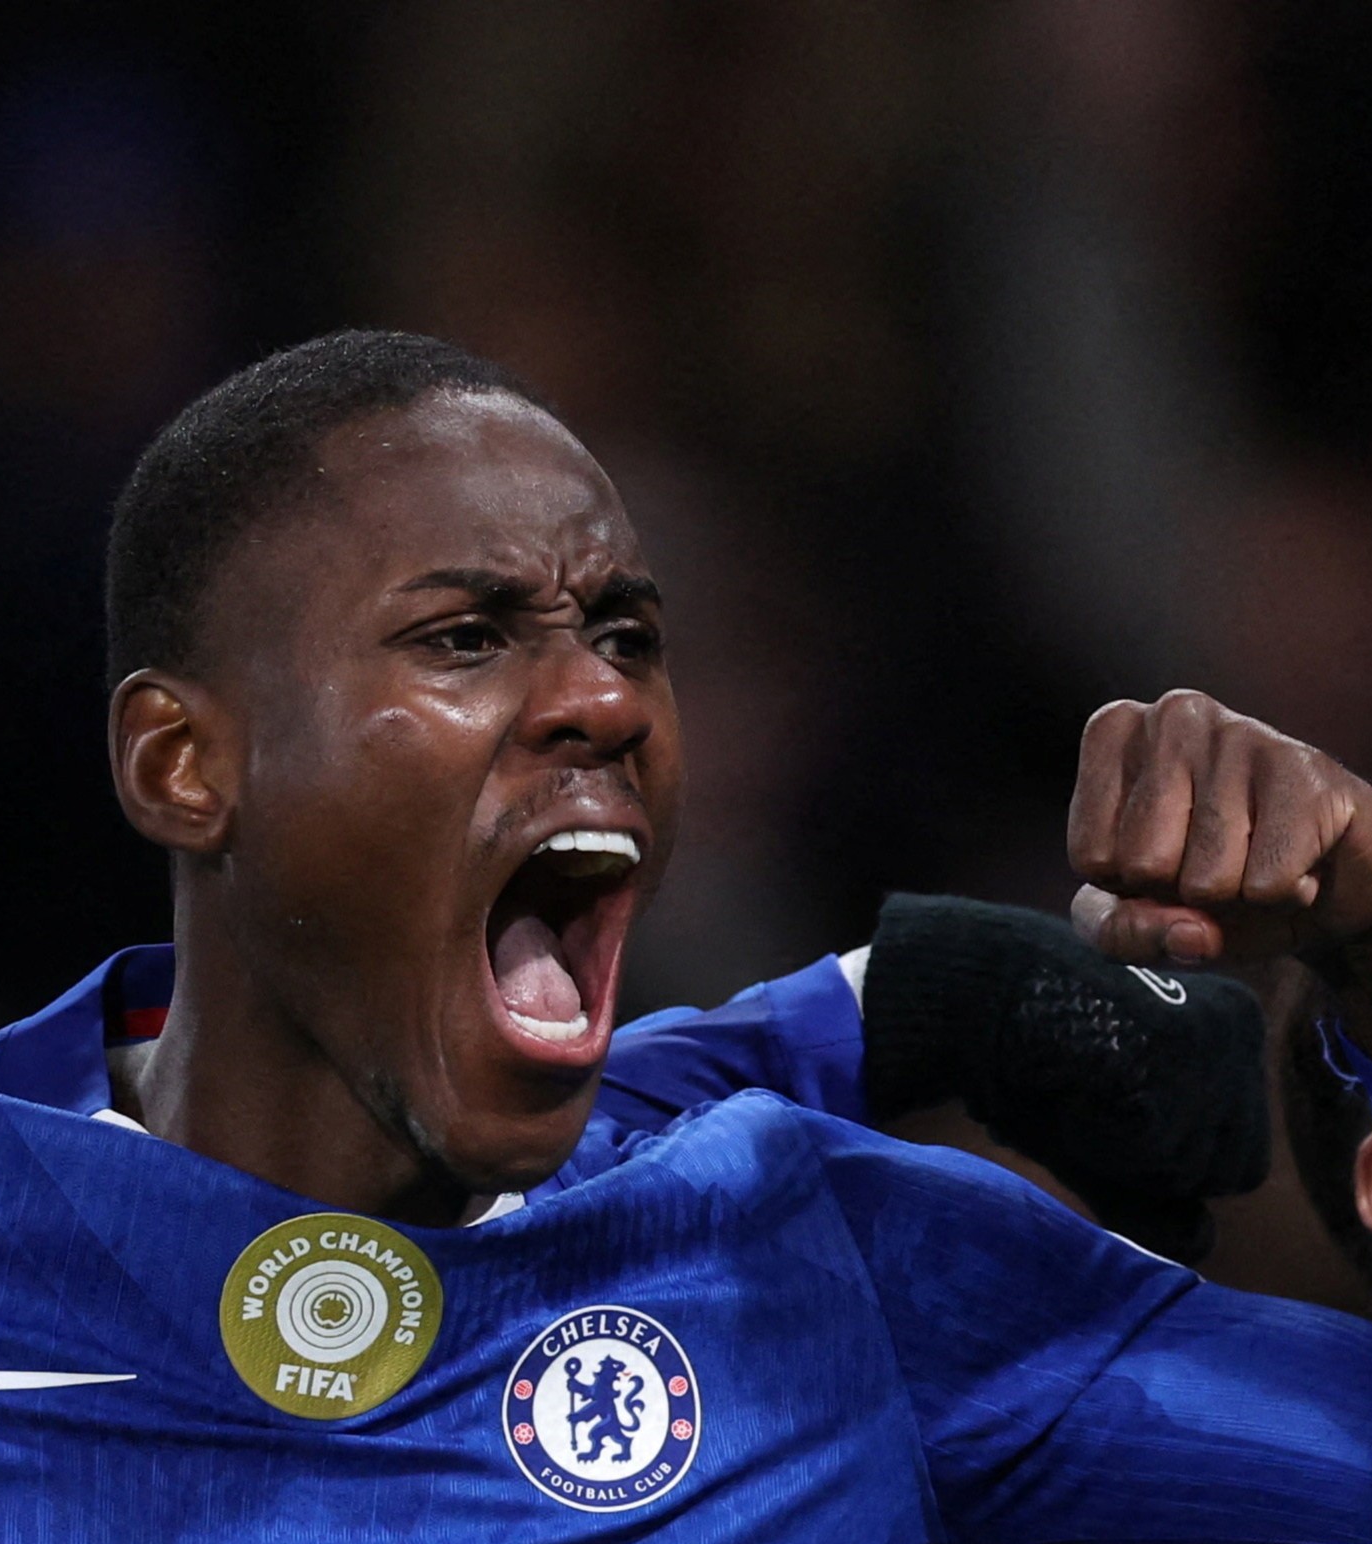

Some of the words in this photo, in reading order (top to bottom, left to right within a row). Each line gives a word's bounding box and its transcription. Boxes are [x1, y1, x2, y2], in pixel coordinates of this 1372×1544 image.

[242, 1237, 311, 1320] WORLD
[319, 1231, 423, 1345] CHAMPIONS
[542, 1314, 662, 1357] CHELSEA
[275, 1363, 354, 1401] FIFA
[541, 1467, 628, 1500] FOOTBALL
[634, 1462, 672, 1492] CLUB
